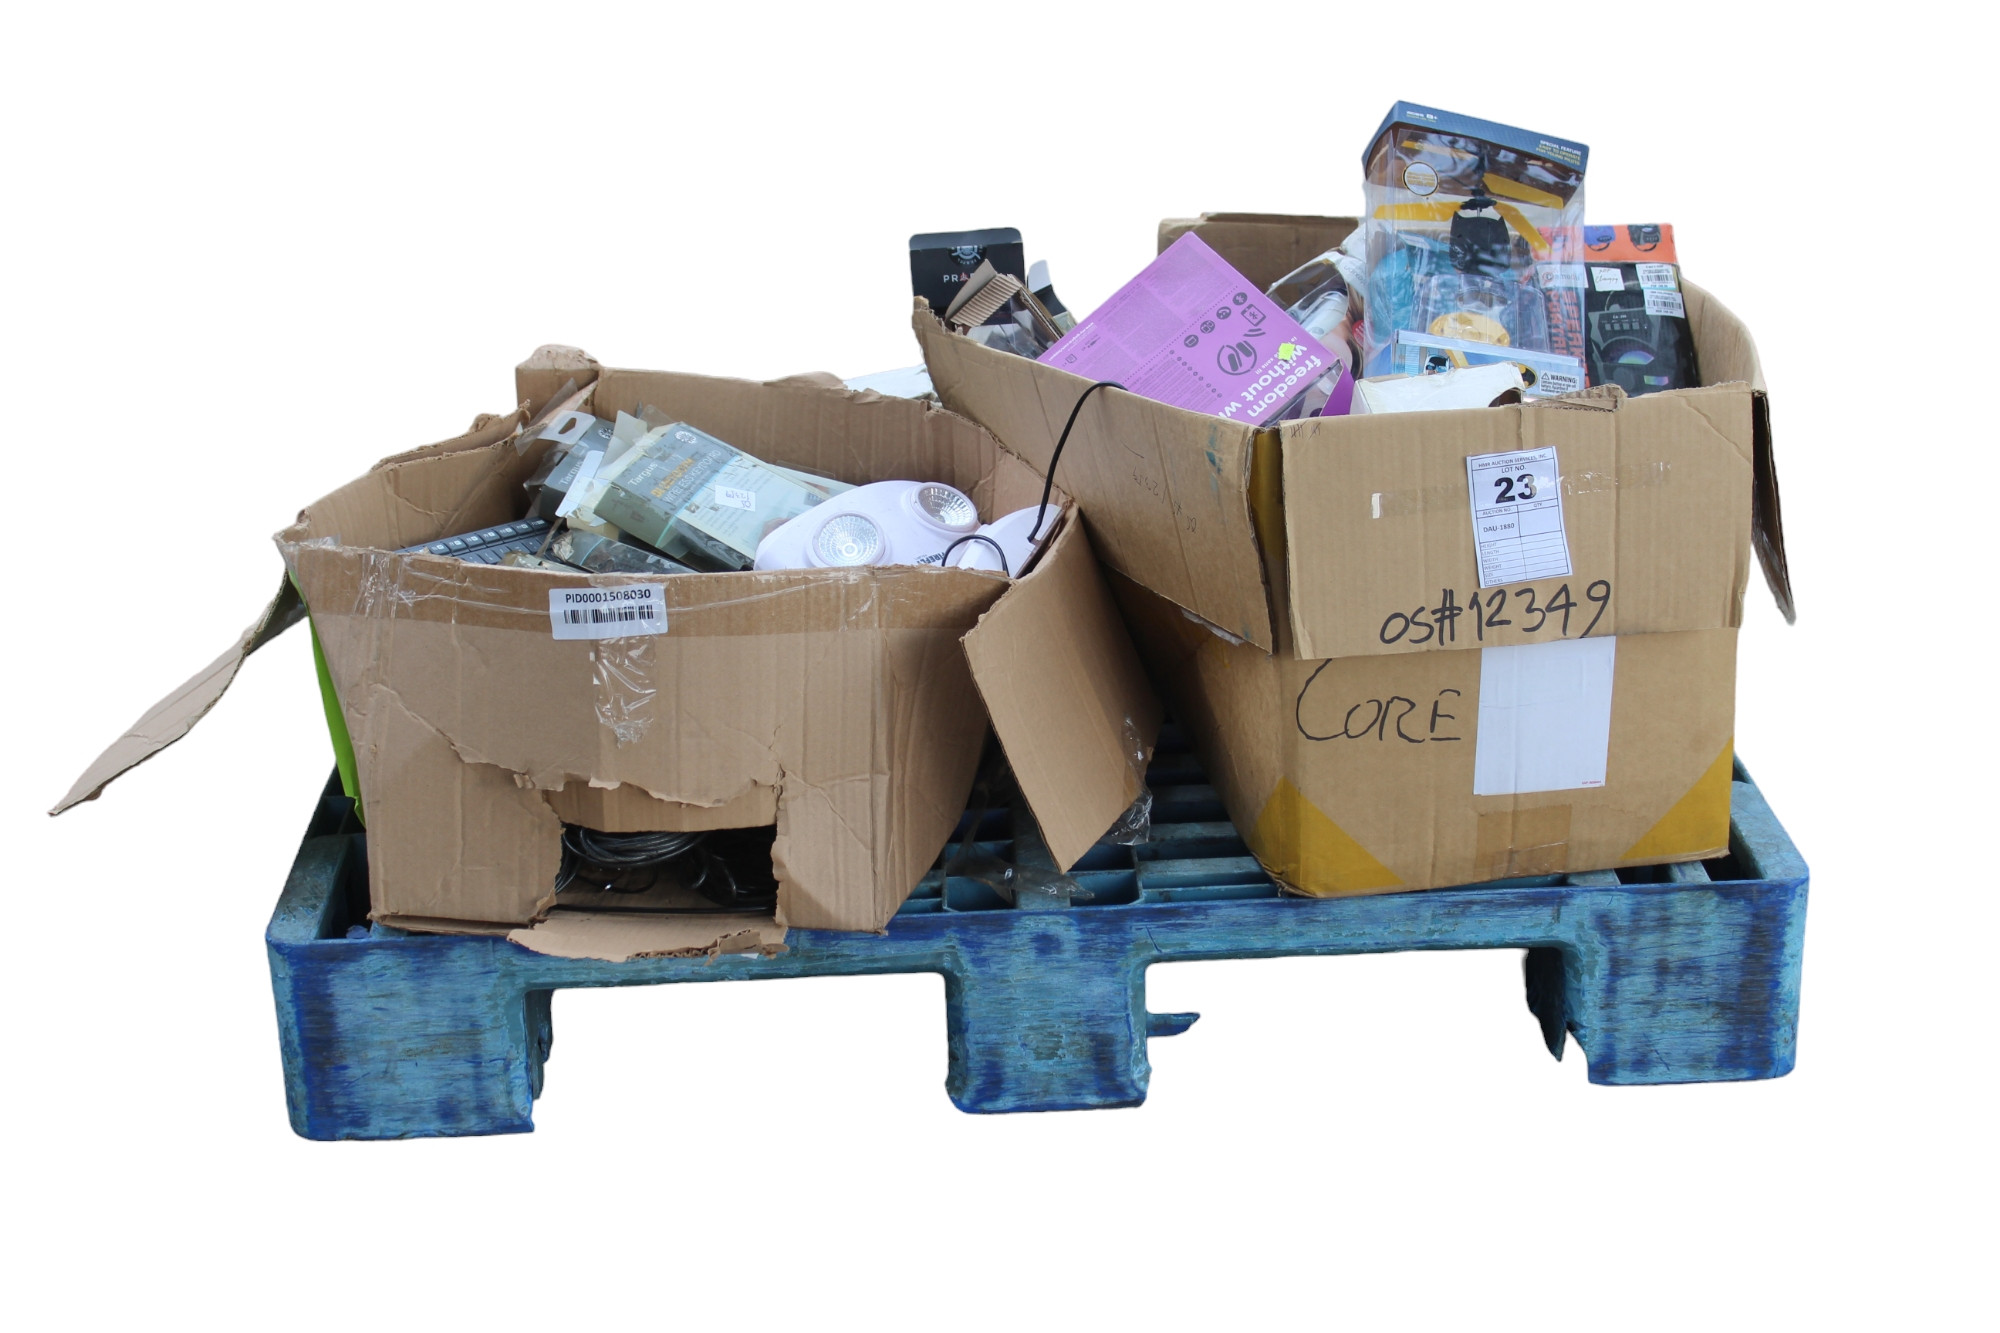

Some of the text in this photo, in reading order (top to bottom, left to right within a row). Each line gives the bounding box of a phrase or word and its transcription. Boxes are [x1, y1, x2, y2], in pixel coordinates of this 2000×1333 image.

[1241, 344, 1308, 402] without
[1247, 355, 1322, 417] freedom
[627, 462, 659, 487] Targus
[1491, 458, 1514, 466] AUCTION
[1494, 473, 1538, 504] 23
[565, 588, 652, 604] PID0001508030
[1296, 658, 1462, 743] CORE
